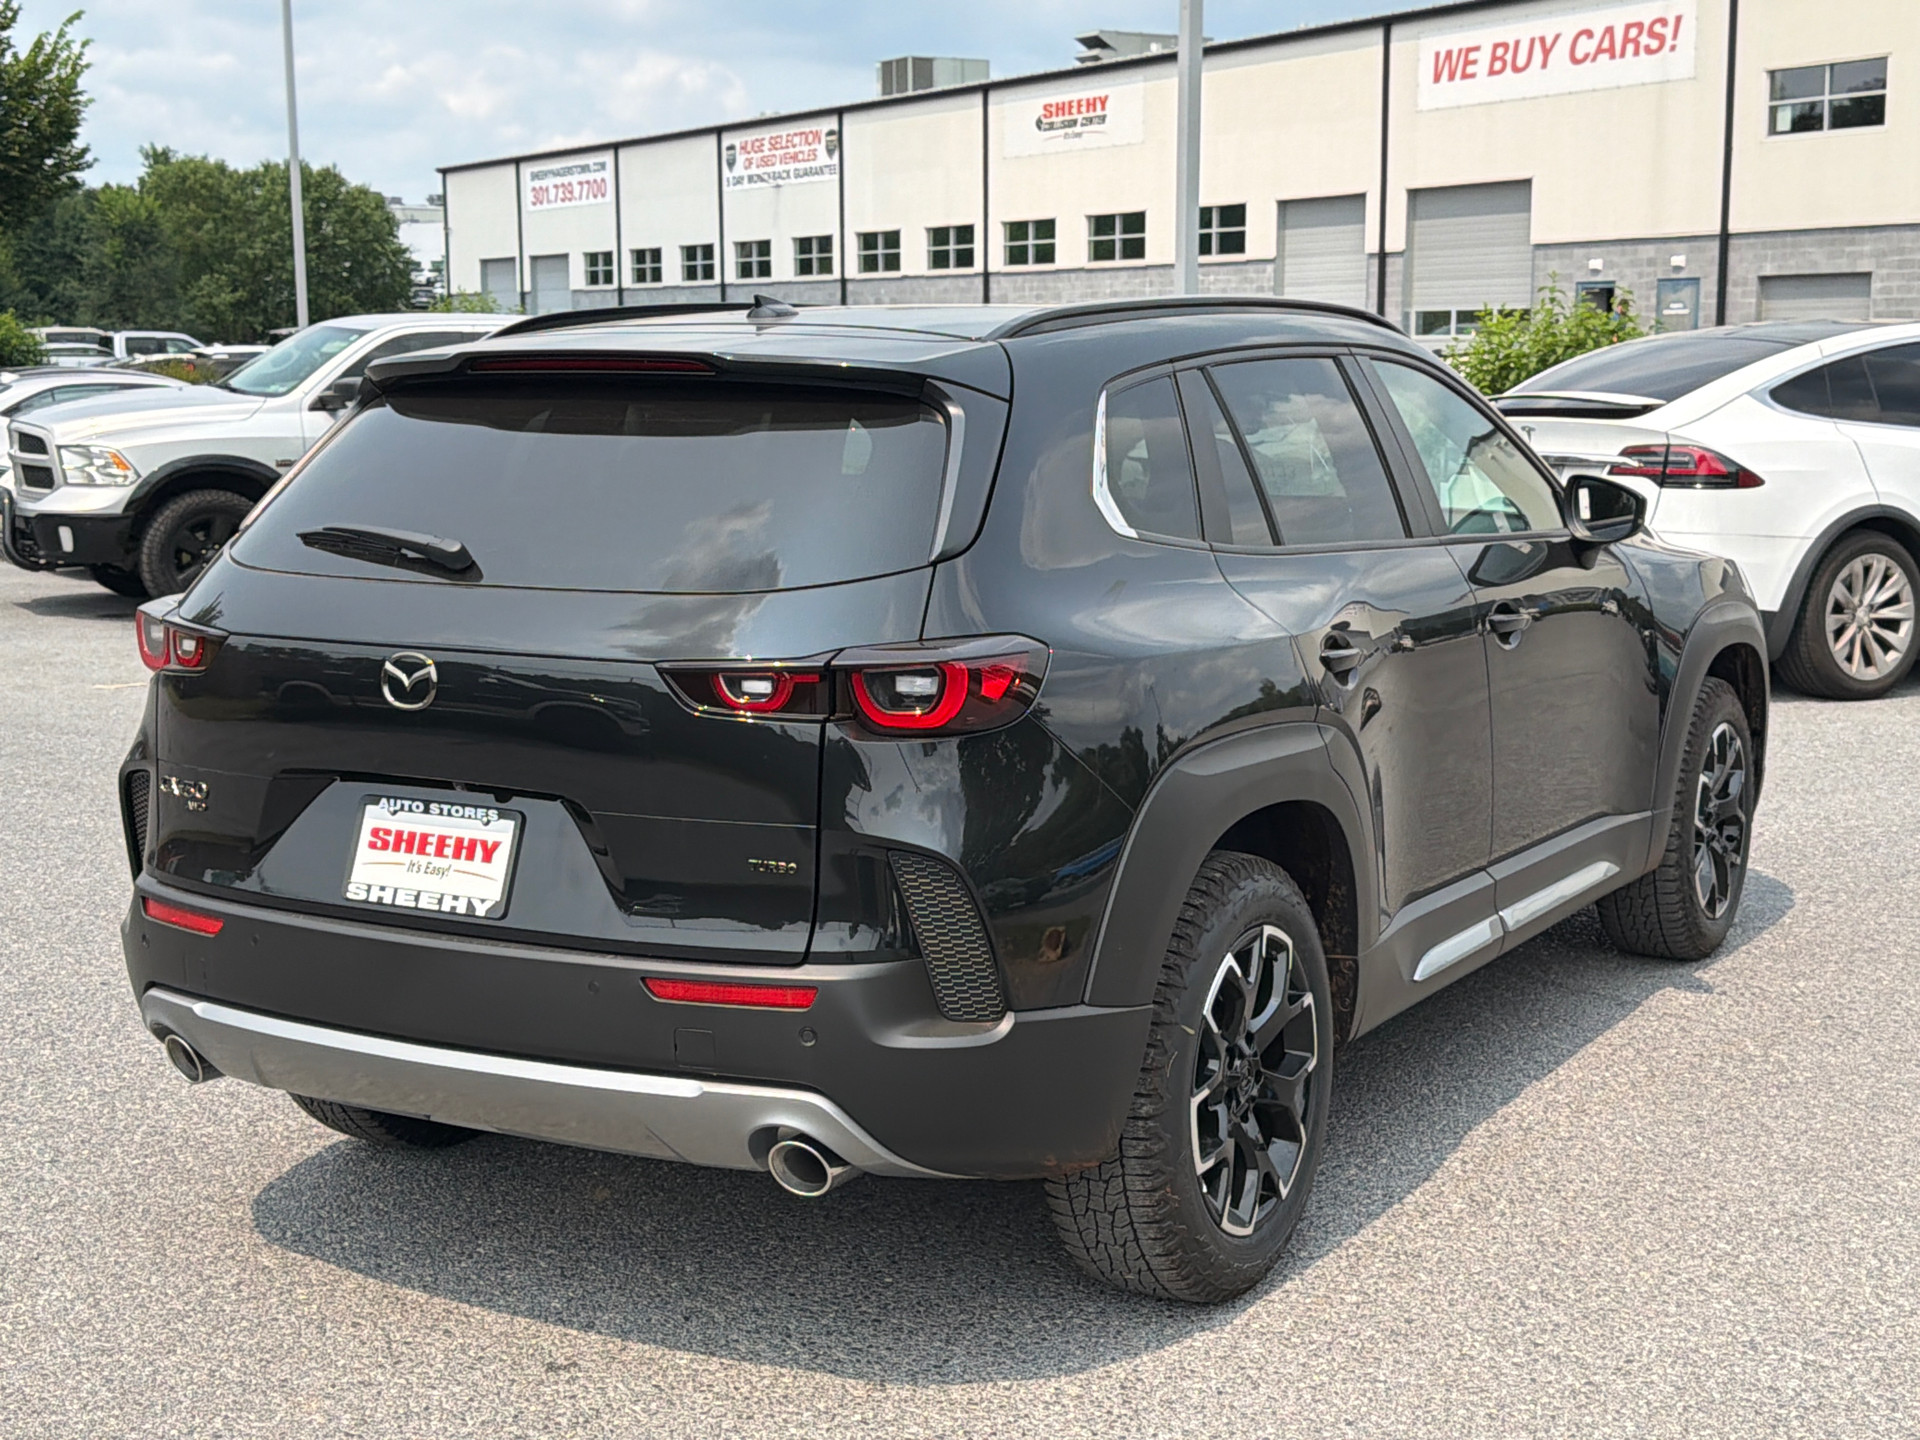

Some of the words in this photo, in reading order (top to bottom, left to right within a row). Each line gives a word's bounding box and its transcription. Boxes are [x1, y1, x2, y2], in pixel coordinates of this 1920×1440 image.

[1432, 45, 1481, 84] WE
[1487, 33, 1561, 77] BUY
[1568, 14, 1683, 66] CARS!
[1042, 94, 1109, 120] SHEEHY
[739, 136, 766, 156] HUGE
[767, 129, 822, 151] SELECTION
[743, 156, 754, 171] OF
[755, 153, 777, 169] USED
[778, 148, 818, 166] VEHICLES
[732, 174, 745, 187] DAY
[793, 163, 838, 180] GUARANTEE
[531, 177, 607, 206] 301.739.7700
[379, 797, 424, 813] AUTO
[429, 803, 499, 821] STORES
[367, 826, 503, 864] SHEEHY
[406, 859, 423, 874] It's
[423, 862, 452, 880] Easy!
[748, 859, 797, 874] TURBO
[346, 882, 495, 917] SHEEHY
